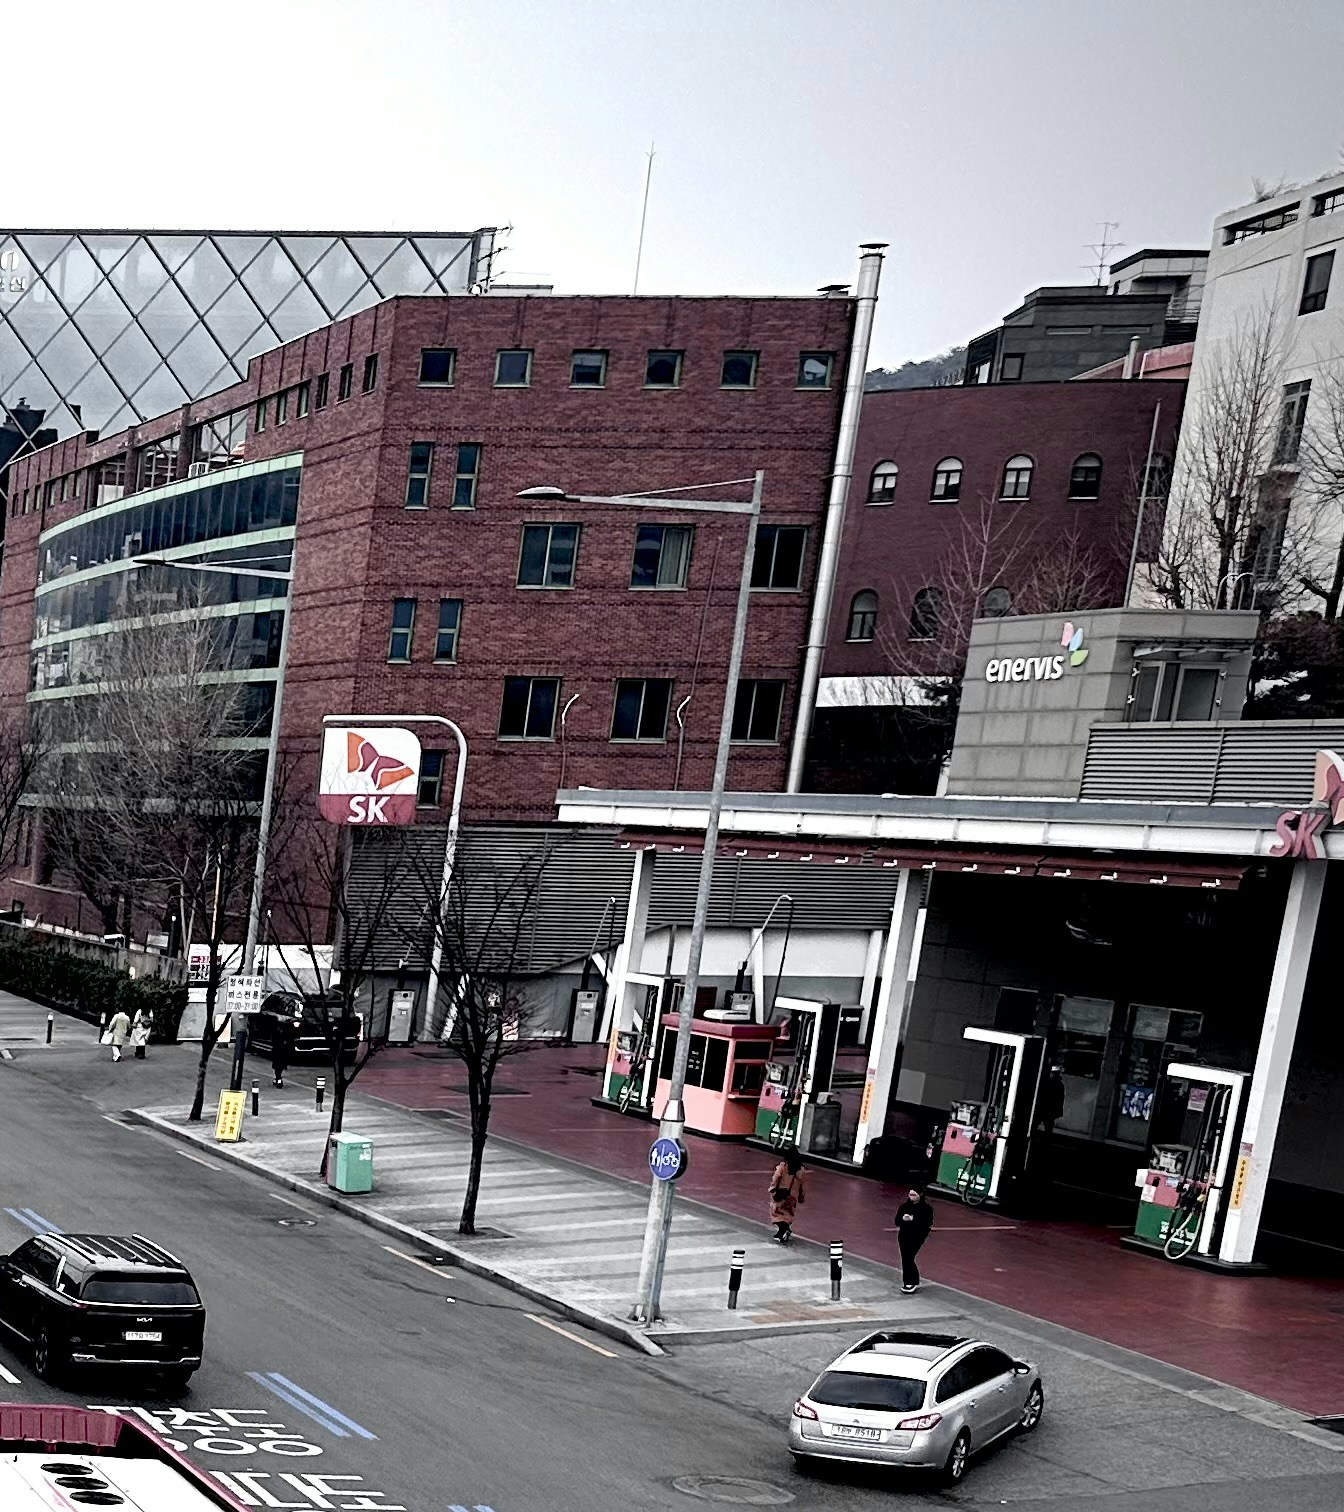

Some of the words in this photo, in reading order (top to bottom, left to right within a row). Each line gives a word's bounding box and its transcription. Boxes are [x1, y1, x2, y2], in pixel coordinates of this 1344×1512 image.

[985, 655, 1064, 682] enervis
[346, 795, 391, 823] SK
[1269, 810, 1328, 859] SK
